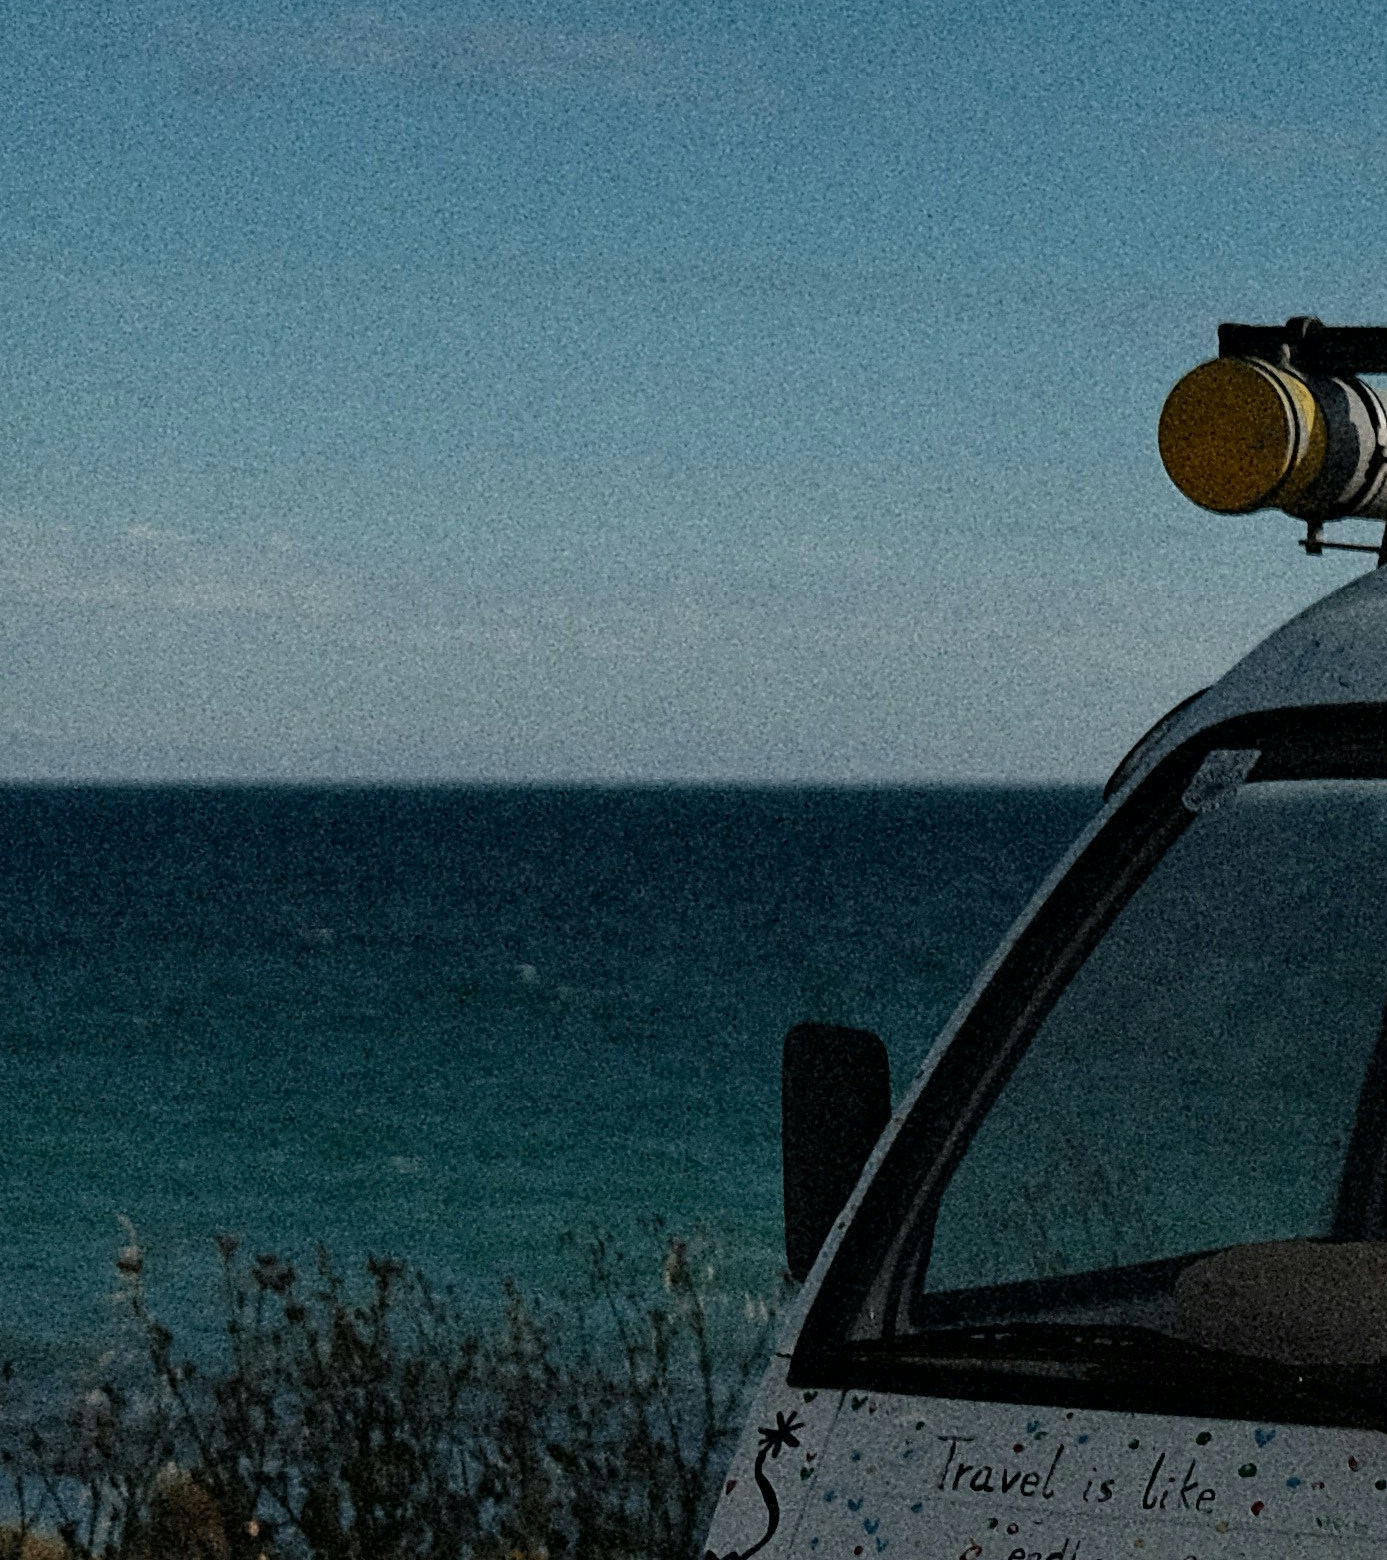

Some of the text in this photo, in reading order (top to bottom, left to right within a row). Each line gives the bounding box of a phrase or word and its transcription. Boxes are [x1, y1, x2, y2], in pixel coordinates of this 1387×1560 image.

[934, 1436, 1217, 1513] Travel is like
